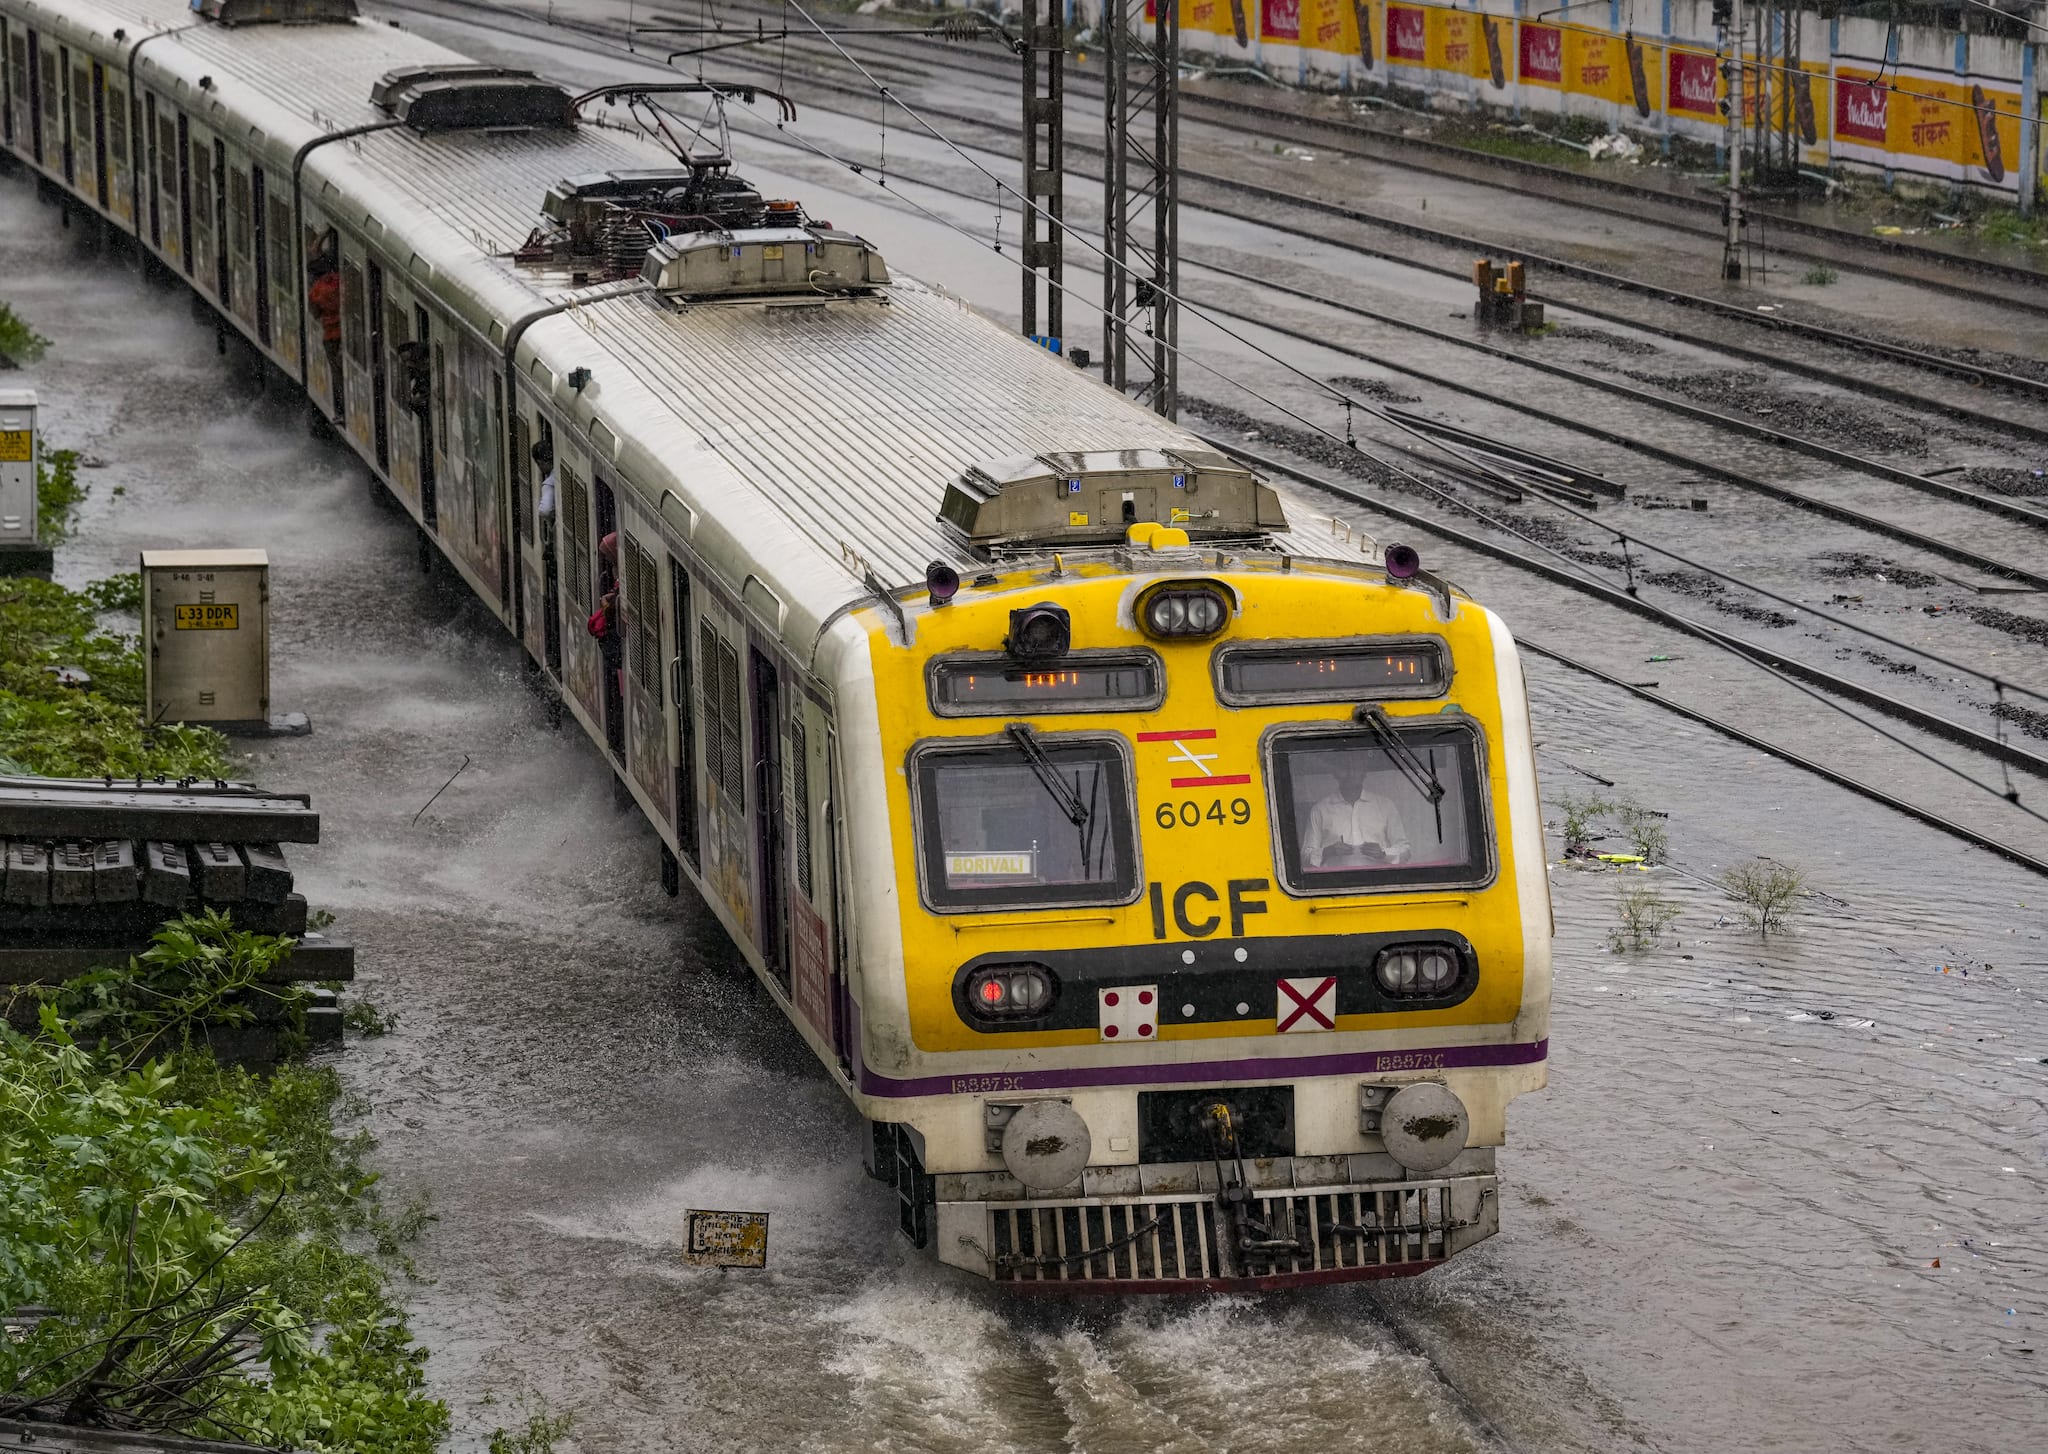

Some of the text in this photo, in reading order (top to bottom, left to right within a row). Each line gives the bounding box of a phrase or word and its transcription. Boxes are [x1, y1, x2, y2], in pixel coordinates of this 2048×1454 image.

[207, 607, 233, 620] DDR
[1155, 797, 1252, 830] 6049
[952, 857, 1024, 873] BORIVALI
[1149, 878, 1271, 940] ICF
[1376, 1053, 1444, 1071] 188879C
[951, 1076, 1024, 1094] 188879C
